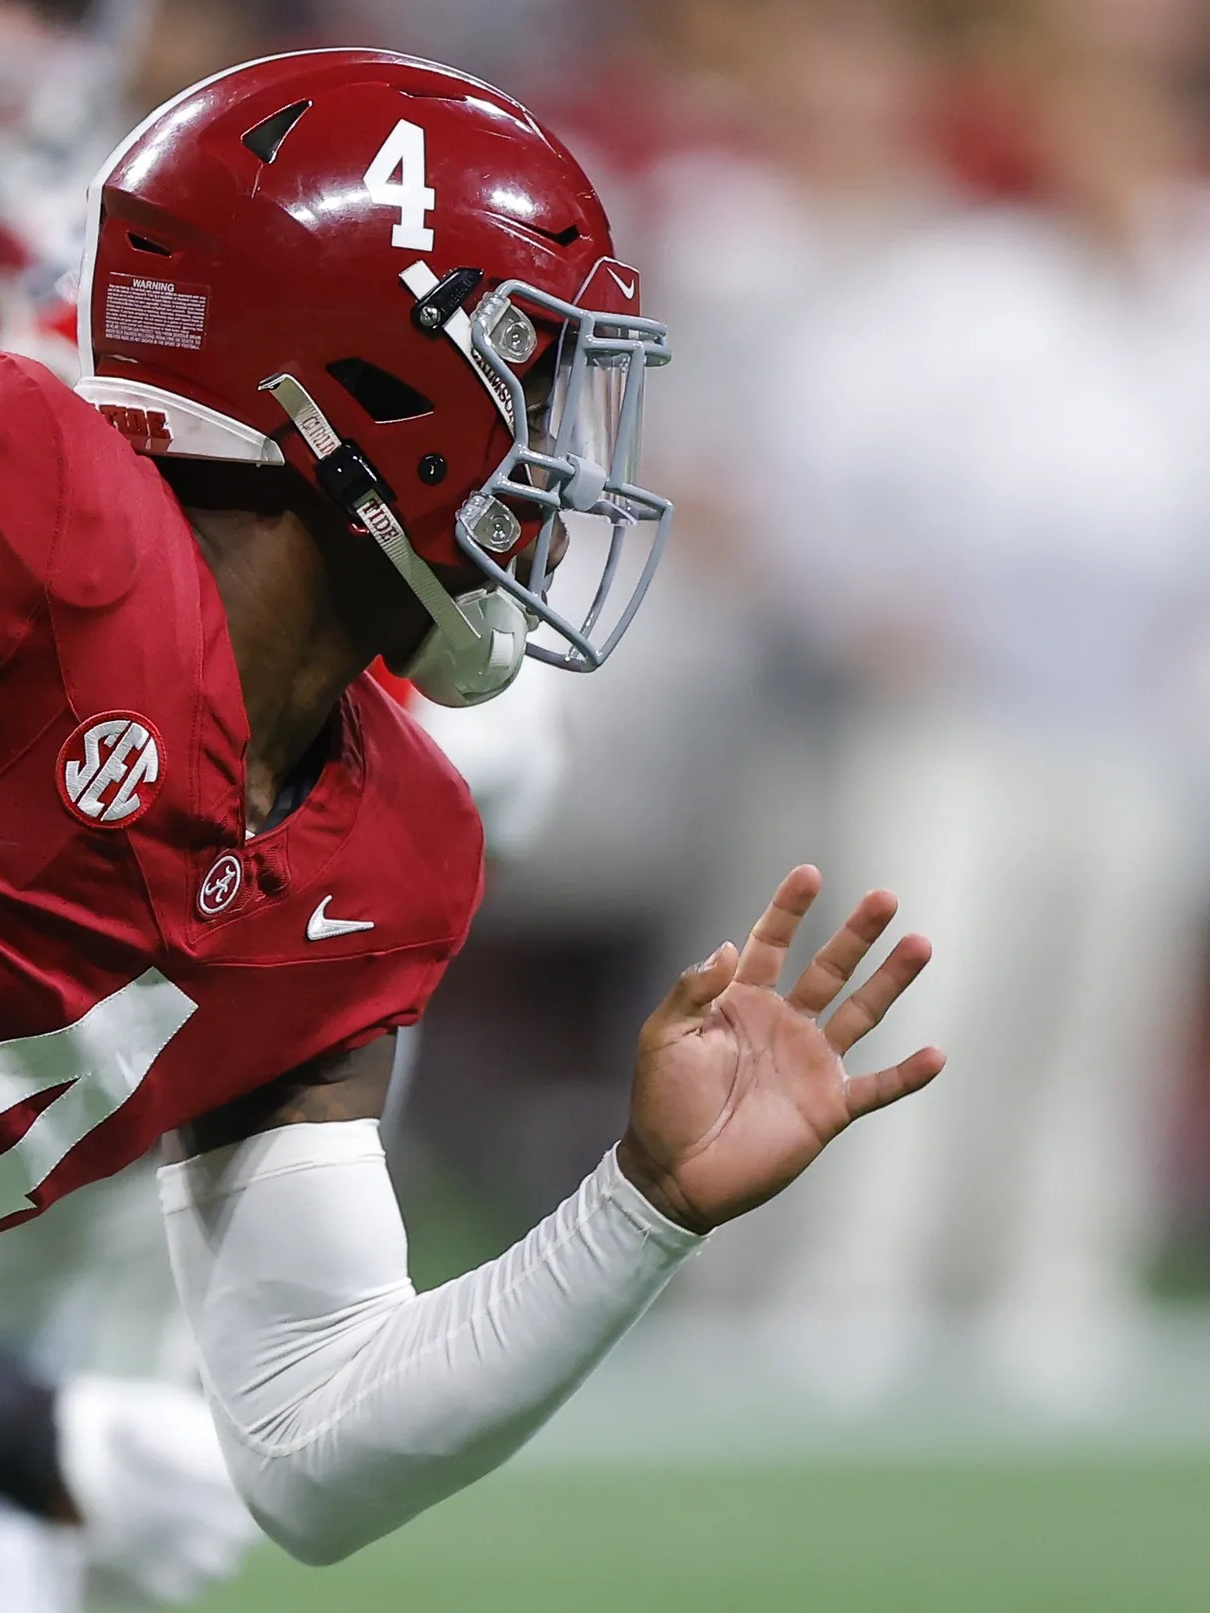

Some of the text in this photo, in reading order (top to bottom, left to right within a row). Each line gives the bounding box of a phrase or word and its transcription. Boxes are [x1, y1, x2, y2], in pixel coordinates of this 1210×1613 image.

[363, 119, 436, 252] 4
[132, 279, 175, 293] WARNING
[362, 498, 399, 543] TIDE
[65, 719, 159, 822] SEC
